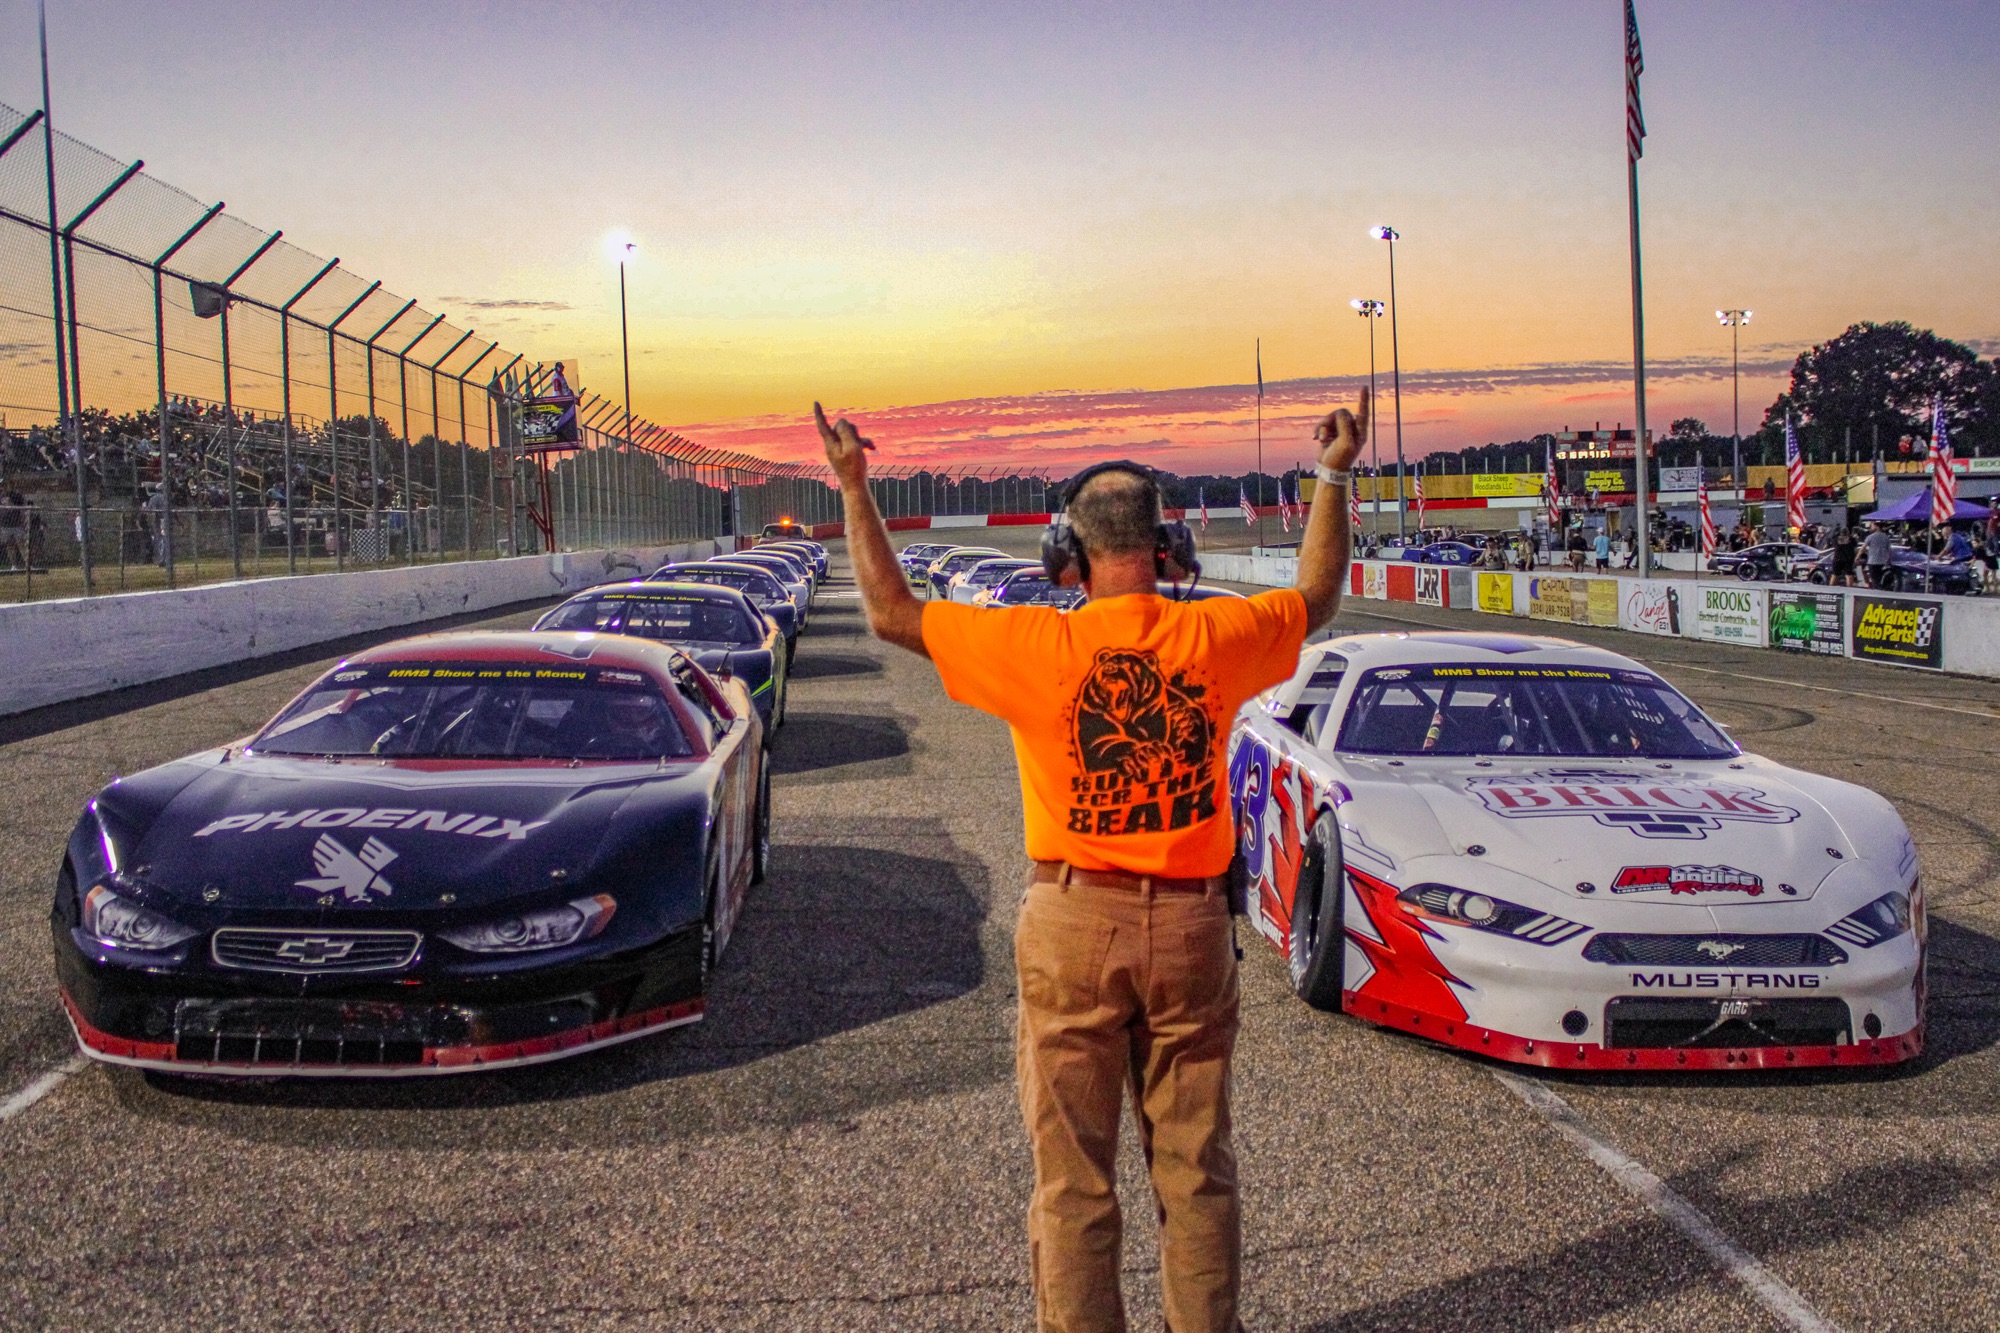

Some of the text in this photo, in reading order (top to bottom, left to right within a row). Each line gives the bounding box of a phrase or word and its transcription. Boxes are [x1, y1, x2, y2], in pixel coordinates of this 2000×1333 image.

[1585, 478, 1611, 487] Supply
[1589, 471, 1621, 479] Builders
[1502, 482, 1513, 490] LLC
[1439, 550, 1460, 561] 75
[1418, 568, 1439, 599] LRR
[1541, 579, 1570, 592] CAPITAL
[1706, 590, 1751, 612] BROOKS
[1530, 603, 1570, 617] (334) 288-7528
[1627, 591, 1667, 632] Range
[1699, 610, 1719, 622] Electrical
[1750, 616, 1760, 626] Inc.
[1862, 603, 1914, 627] Advance
[1659, 621, 1669, 630] 231
[1856, 622, 1913, 643] Auto Parts
[388, 669, 430, 678] MMS
[433, 669, 474, 678] Show
[505, 670, 531, 678] the
[535, 670, 587, 680] Money
[1433, 668, 1473, 676] MMS
[1476, 668, 1515, 676] Show
[1542, 669, 1565, 678] the
[1567, 670, 1612, 680] Money
[1077, 760, 1217, 807] FOR THE
[1230, 731, 1272, 882] 43
[1487, 785, 1784, 814] BRICK
[1067, 780, 1217, 837] BEAR
[193, 808, 551, 840] PHOENIX
[1671, 869, 1760, 885] bodies
[1262, 916, 1284, 949] GARC
[1632, 973, 1820, 988] MUSTANG
[1720, 1001, 1748, 1015] GARC
